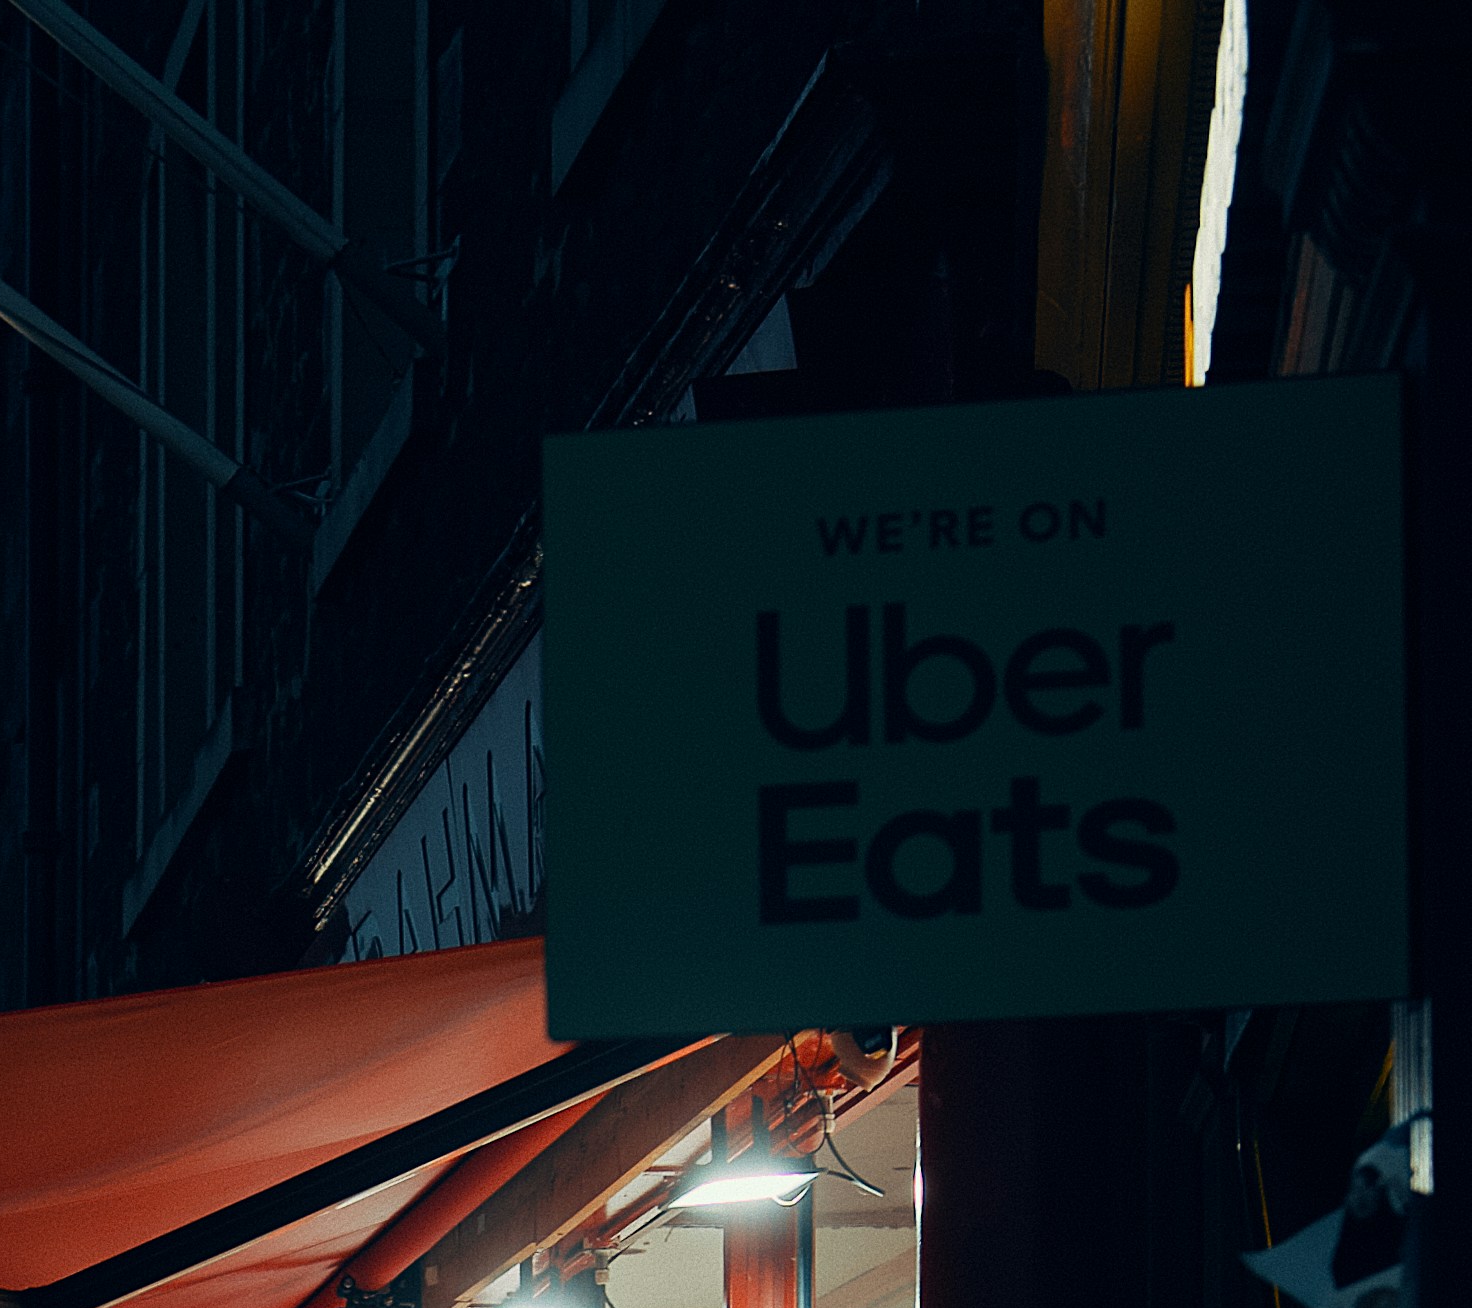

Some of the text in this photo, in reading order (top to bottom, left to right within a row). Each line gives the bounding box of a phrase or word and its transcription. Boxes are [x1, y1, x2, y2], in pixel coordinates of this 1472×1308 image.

[816, 499, 1110, 557] WE'RE ON
[754, 601, 1177, 752] Uber
[756, 776, 1180, 926] Eats
